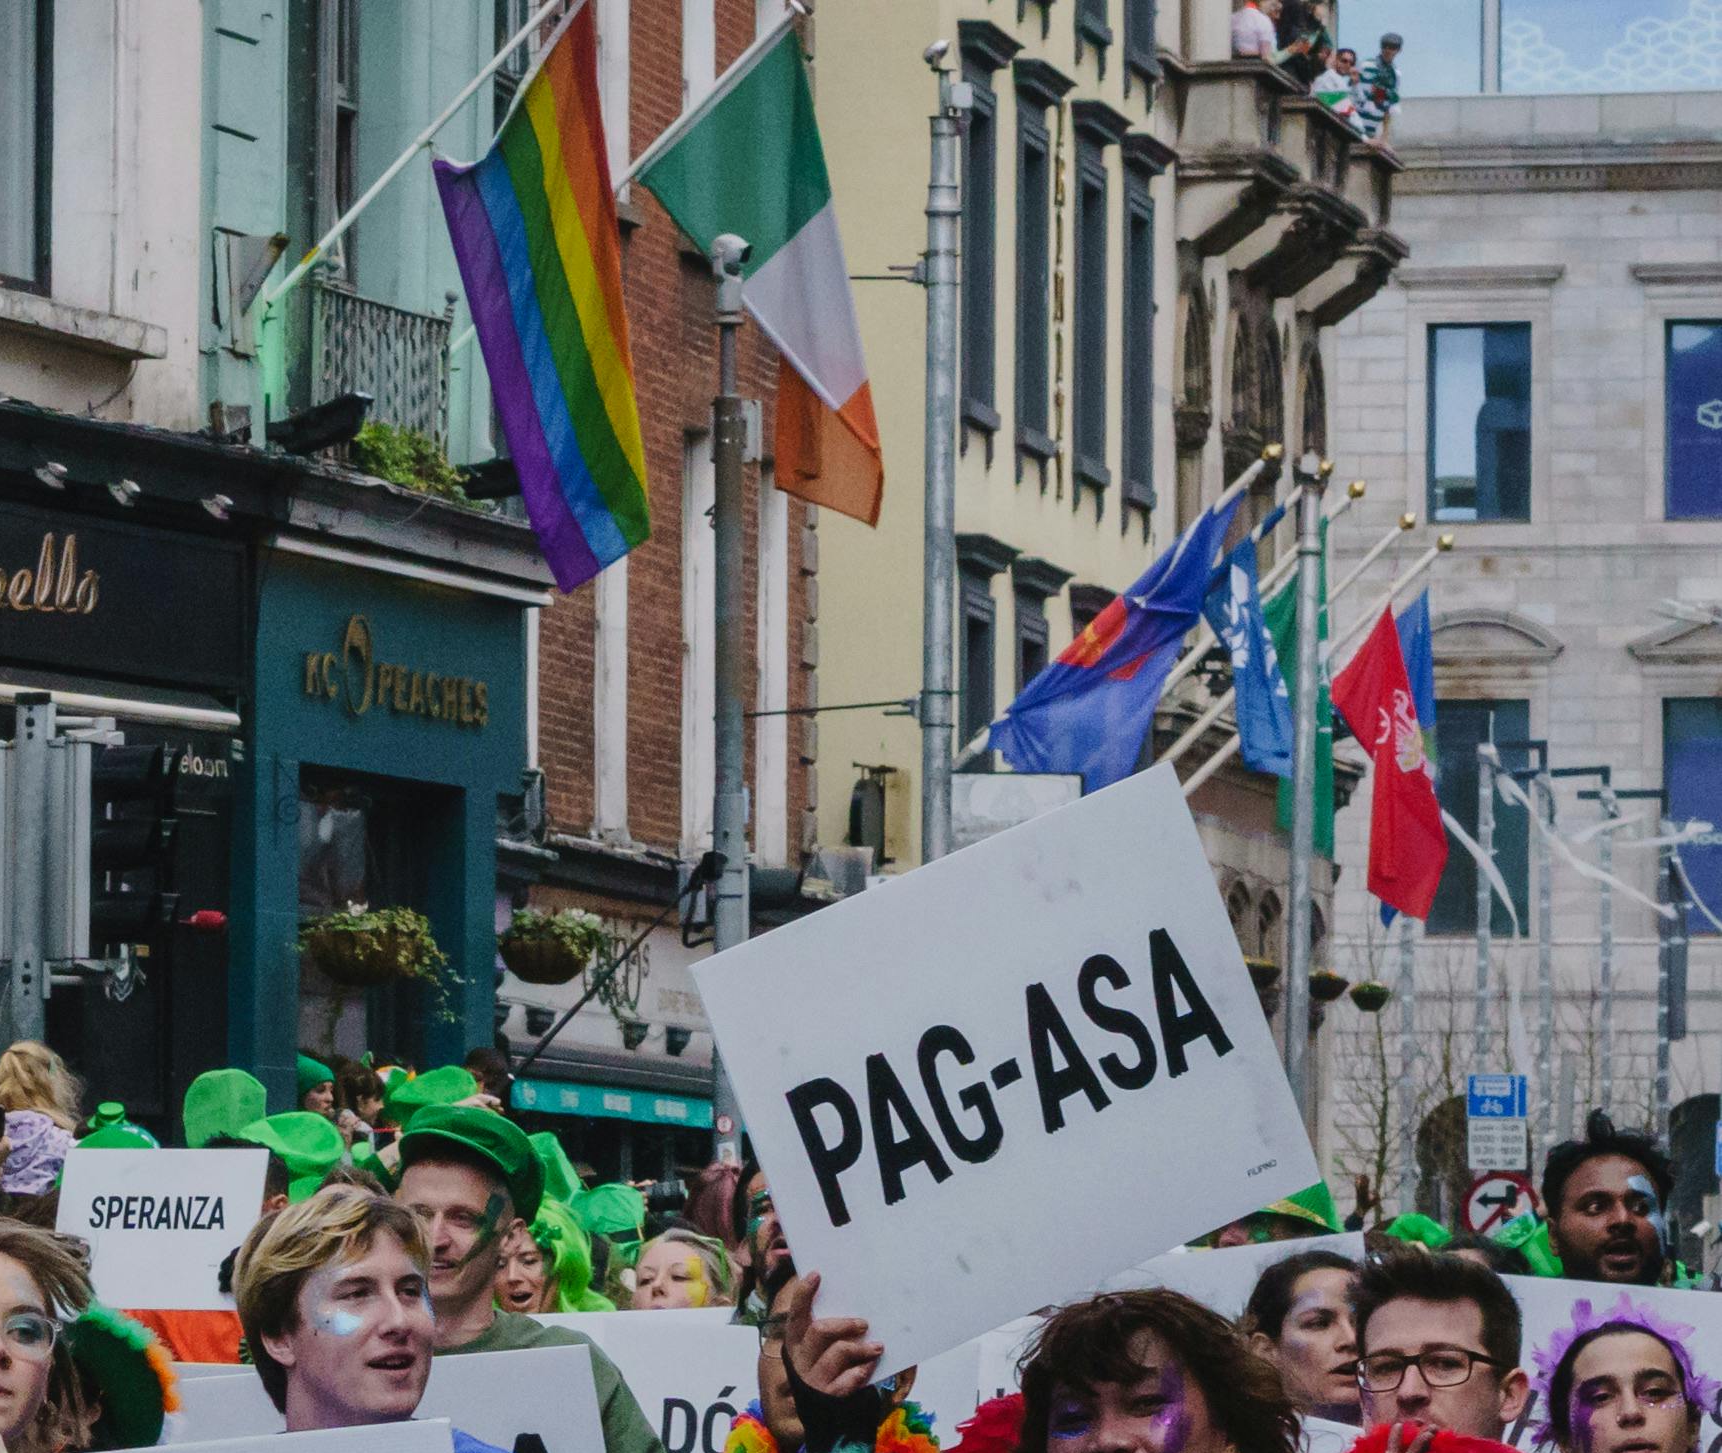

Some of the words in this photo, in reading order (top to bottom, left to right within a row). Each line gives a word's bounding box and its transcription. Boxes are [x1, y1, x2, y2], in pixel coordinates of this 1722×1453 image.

[304, 652, 338, 699] KC
[377, 660, 489, 727] PEACHES
[785, 927, 1235, 1227] PAG-ASA
[89, 1196, 225, 1230] SPERANZA
